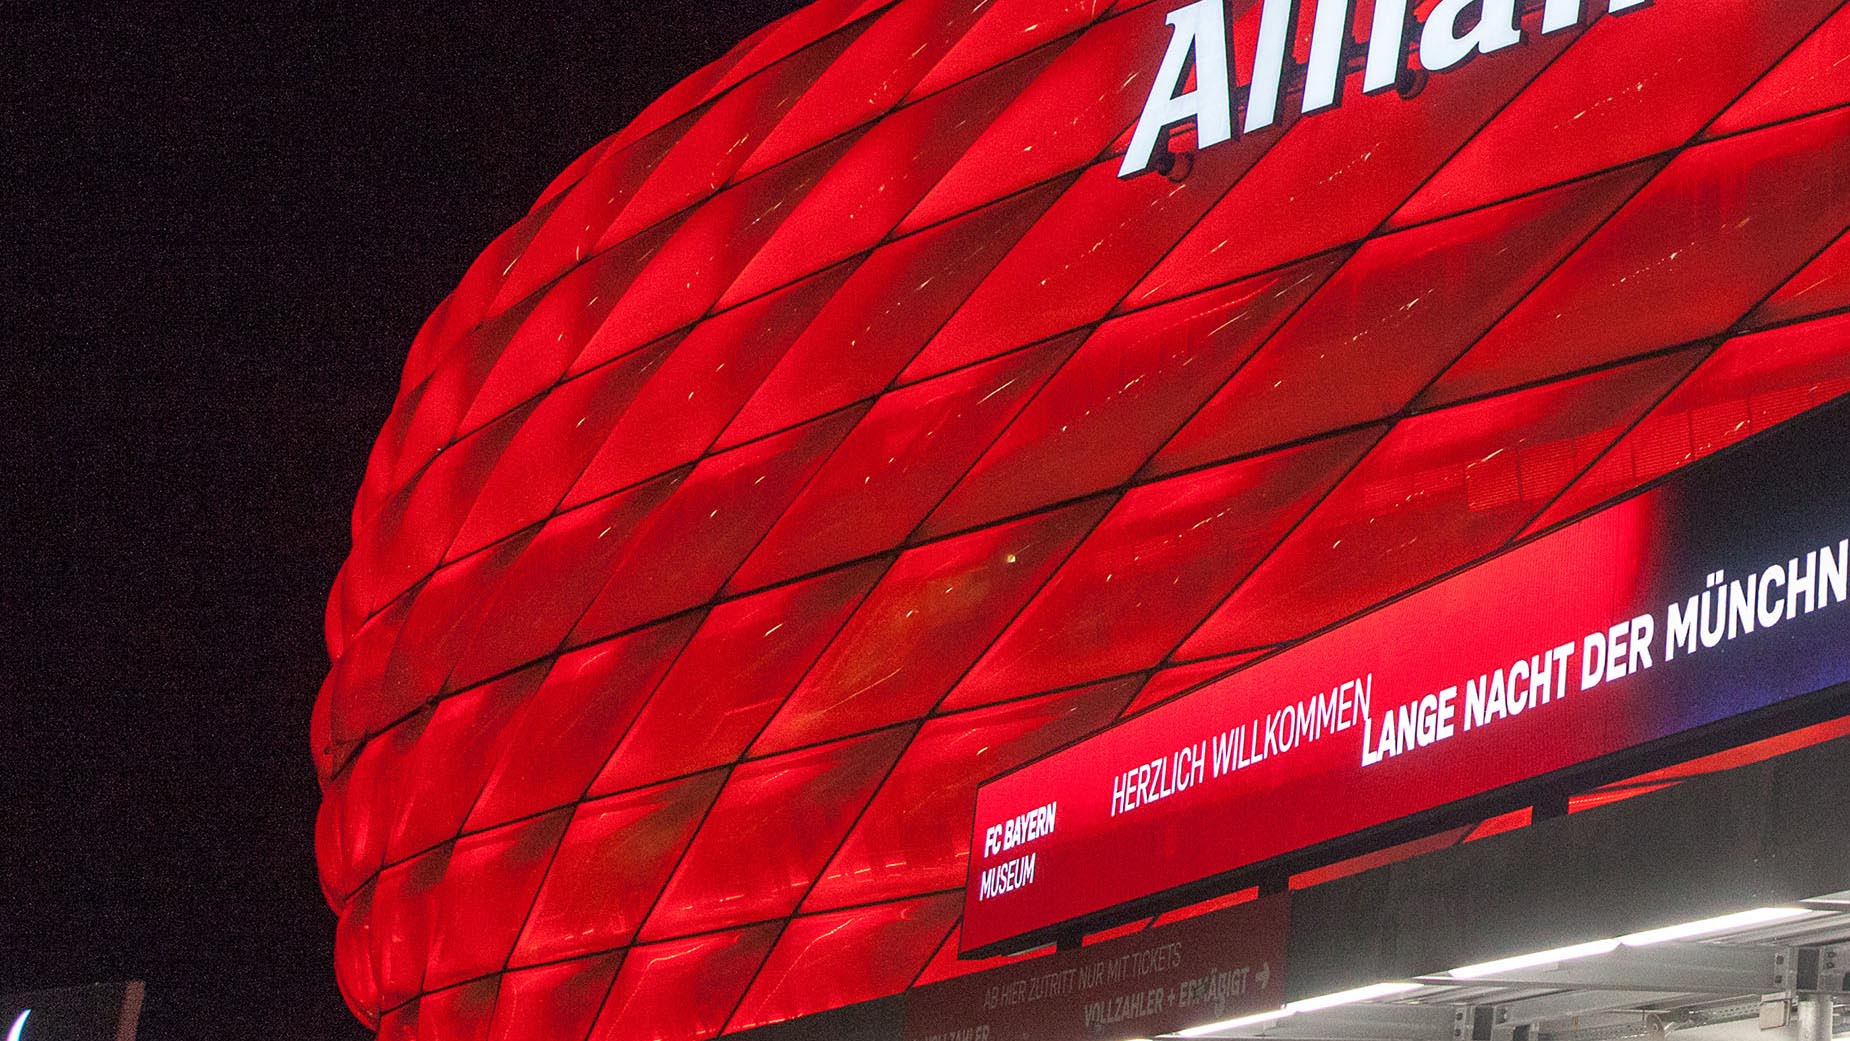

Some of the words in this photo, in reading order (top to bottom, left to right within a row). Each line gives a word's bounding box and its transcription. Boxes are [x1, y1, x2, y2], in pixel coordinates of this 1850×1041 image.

[1361, 686, 1458, 767] LANGE
[1463, 640, 1575, 732] NACHT
[1580, 613, 1655, 691] DER
[1111, 740, 1207, 818] HERZLICH
[1212, 673, 1373, 778] WILLKOMMEN
[984, 823, 1003, 859] FC
[1003, 801, 1058, 852] BAYERN
[979, 852, 1037, 902] MUSEUM
[1002, 979, 1027, 1005] HIER
[1028, 968, 1078, 1001] ZUTRITT
[1078, 961, 1104, 991] NUR
[1106, 955, 1131, 982] MIT
[1132, 941, 1183, 977] TICKETS
